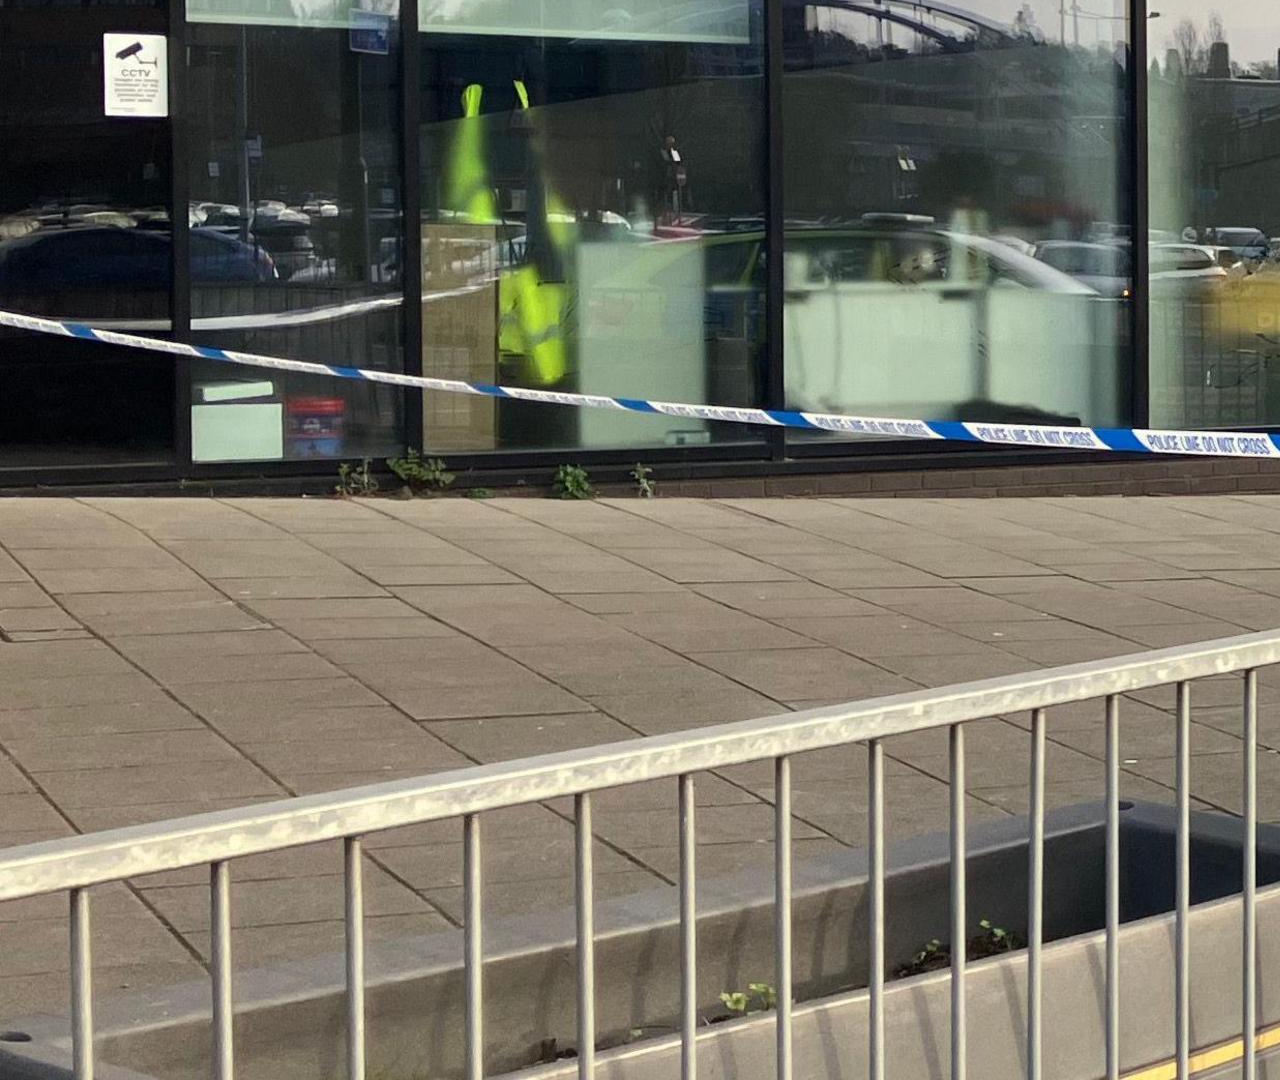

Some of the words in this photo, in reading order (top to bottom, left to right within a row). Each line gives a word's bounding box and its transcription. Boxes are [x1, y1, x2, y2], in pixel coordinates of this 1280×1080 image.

[121, 69, 151, 77] CCTV
[977, 427, 1009, 442] POLICE
[1010, 428, 1031, 443] LINE
[1032, 430, 1044, 443] DO
[1046, 431, 1063, 444] NOT
[1065, 432, 1096, 447] CROSS
[1148, 434, 1180, 451] POLICE
[1181, 436, 1200, 451] LINE
[1202, 436, 1216, 452] DO
[1217, 437, 1236, 453] NOT
[1237, 438, 1270, 454] CROSS
